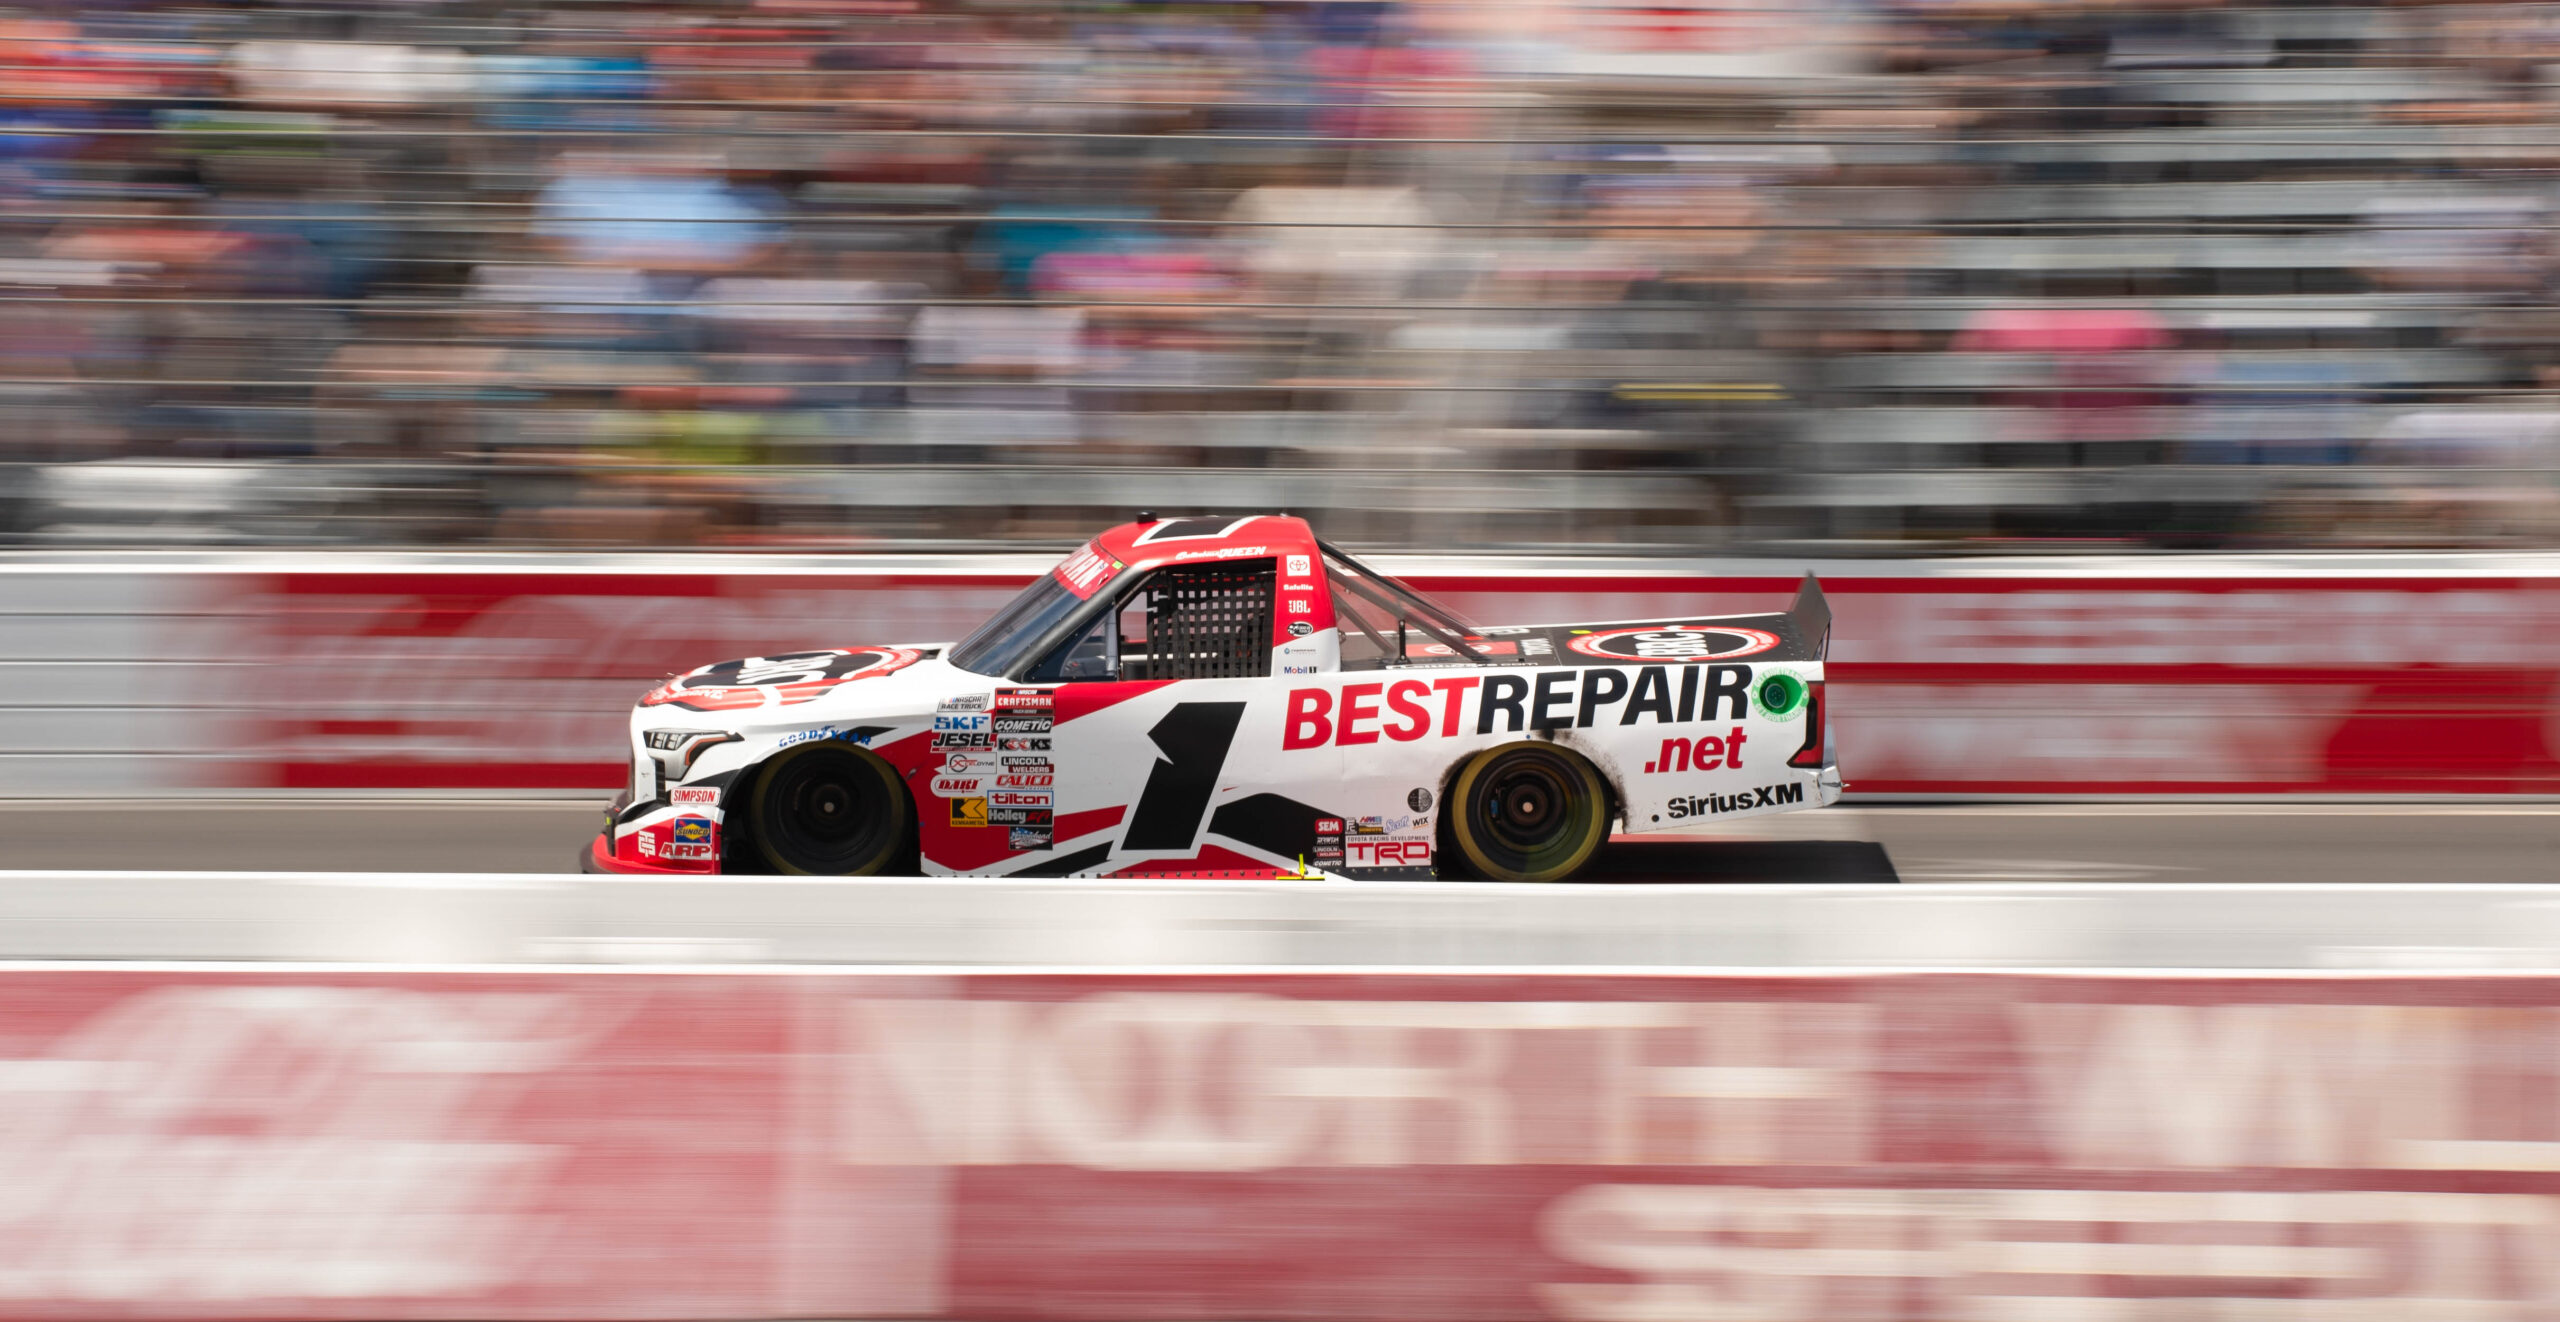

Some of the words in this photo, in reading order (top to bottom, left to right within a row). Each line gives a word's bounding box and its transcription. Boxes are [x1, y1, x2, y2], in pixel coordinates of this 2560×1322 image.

[1288, 600, 1311, 613] JBL
[1284, 666, 1308, 674] Mobil
[998, 697, 1052, 706] CRAFTSMAN
[1282, 664, 1752, 751] BESTREPAIR
[934, 717, 988, 729] SKF
[994, 719, 1052, 731] COMETIC
[778, 725, 872, 747] GOODYEAR
[932, 733, 993, 746] JESEL
[1644, 726, 1747, 774] .net
[1003, 757, 1045, 765] LINCOLN
[996, 775, 1053, 787] CALICO
[1120, 702, 1247, 850] 1
[673, 790, 716, 802] SIMPSON
[991, 793, 1049, 805] tilton
[1668, 782, 1804, 819] SiriusXM
[988, 808, 1027, 824] Holley
[1318, 822, 1339, 832] SEM
[1412, 817, 1429, 828] WIX
[676, 827, 709, 837] SUNOCO
[661, 845, 711, 857] ARP
[1347, 842, 1429, 865] TRD
